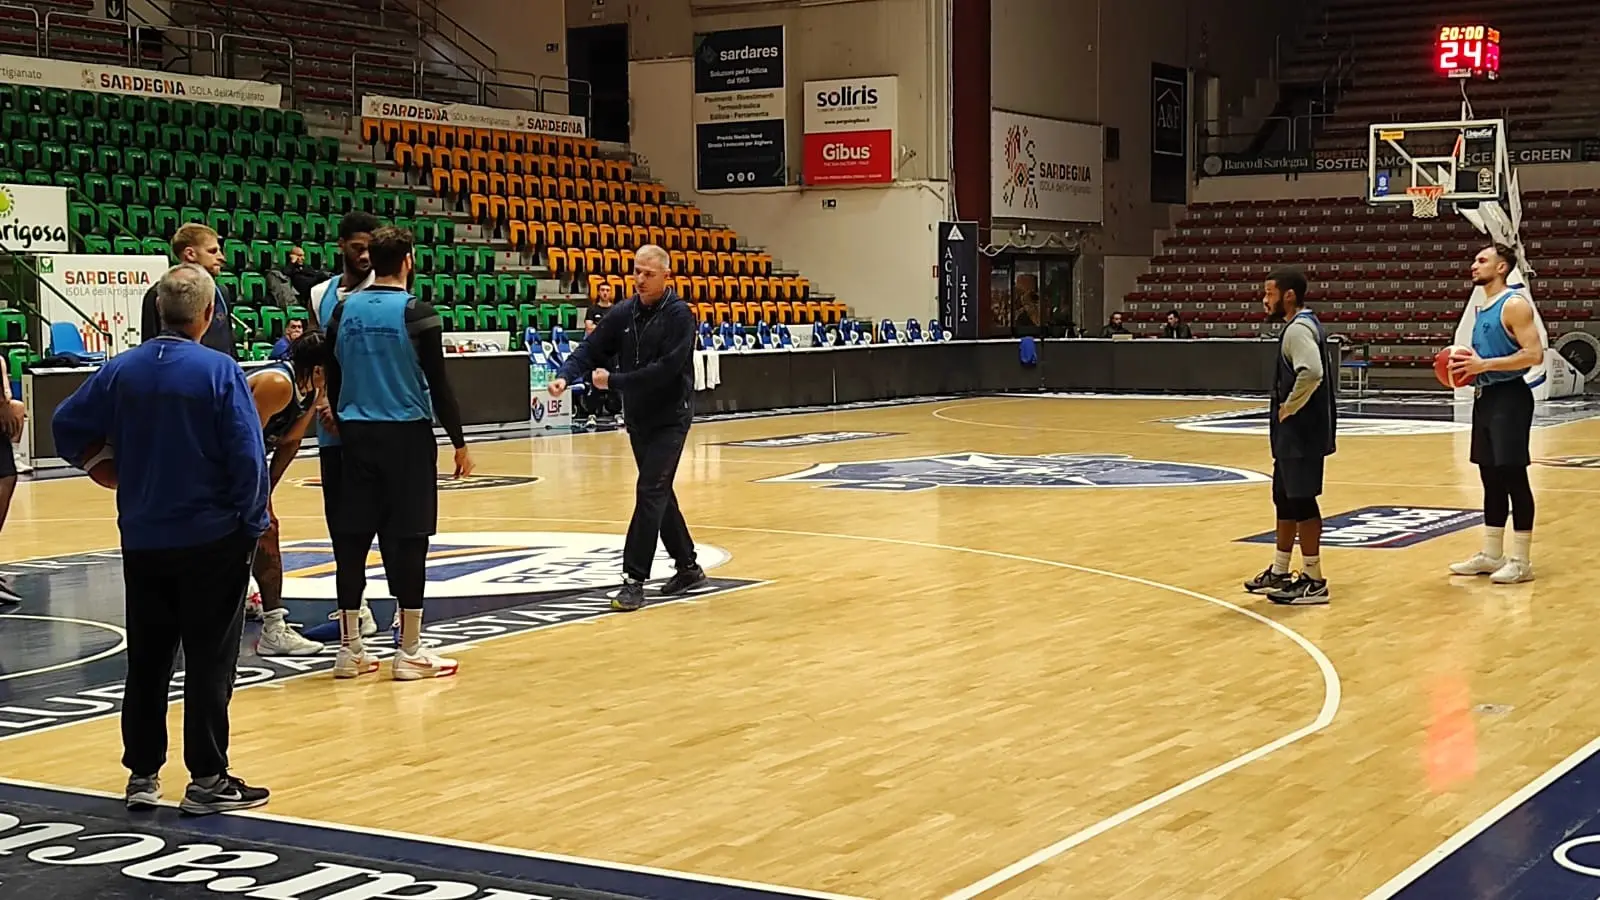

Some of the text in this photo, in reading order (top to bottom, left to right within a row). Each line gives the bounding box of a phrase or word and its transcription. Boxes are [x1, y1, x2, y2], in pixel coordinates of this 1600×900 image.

[1440, 25, 1484, 40] 20:00
[719, 45, 778, 61] sardares
[1440, 40, 1482, 68] 24
[100, 73, 186, 96] SARDEGNA
[817, 85, 878, 107] soliris
[381, 102, 449, 122] SARDEGNA
[527, 117, 583, 134] SARDEGNA
[822, 143, 870, 160] Gibus
[1316, 156, 1407, 170] SOSTENAMO
[1520, 149, 1572, 161] GREEN
[1039, 162, 1091, 182] SARDEGNA
[1225, 160, 1252, 170] Banco
[1264, 157, 1308, 170] Sardegna
[64, 271, 150, 285] SARDEGNA
[959, 275, 968, 322] ITALIA
